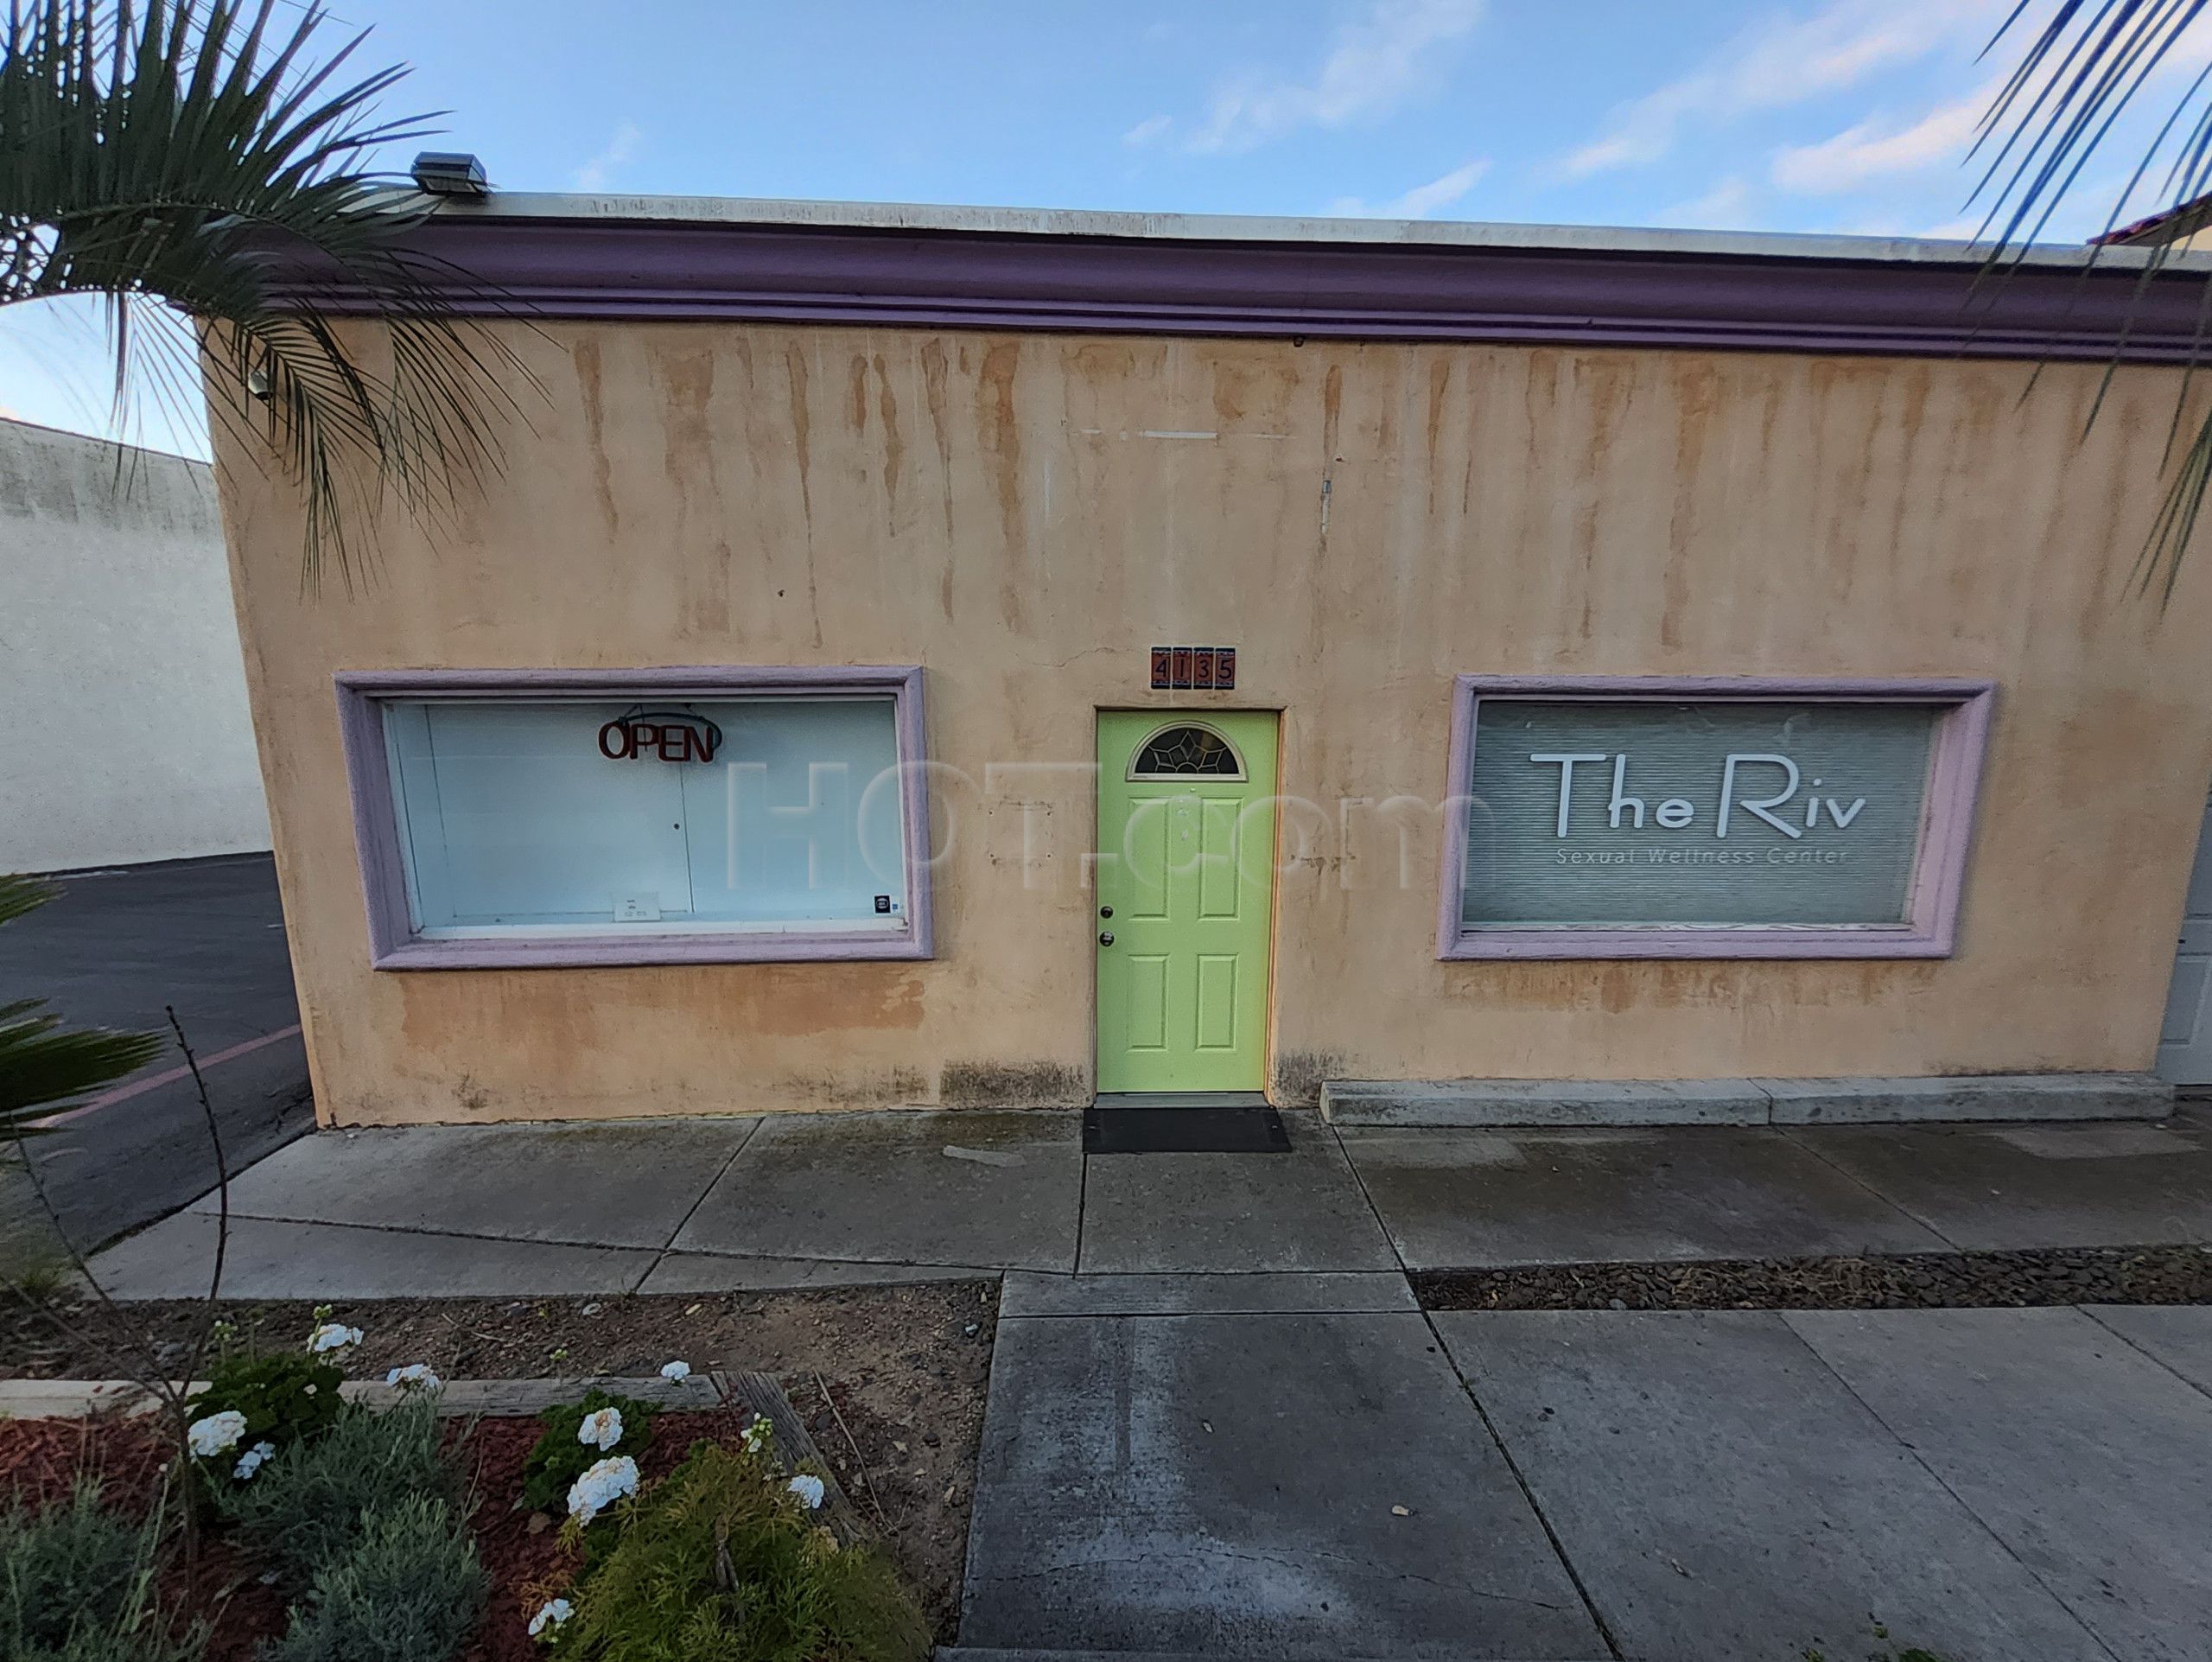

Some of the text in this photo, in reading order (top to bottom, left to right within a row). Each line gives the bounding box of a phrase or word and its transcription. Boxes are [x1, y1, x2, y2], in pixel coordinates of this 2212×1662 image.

[1154, 658, 1232, 679] 4135
[598, 720, 715, 763] OPEN
[1529, 753, 1866, 839] The Riv
[1555, 847, 1849, 865] Sexual Wellness Center
